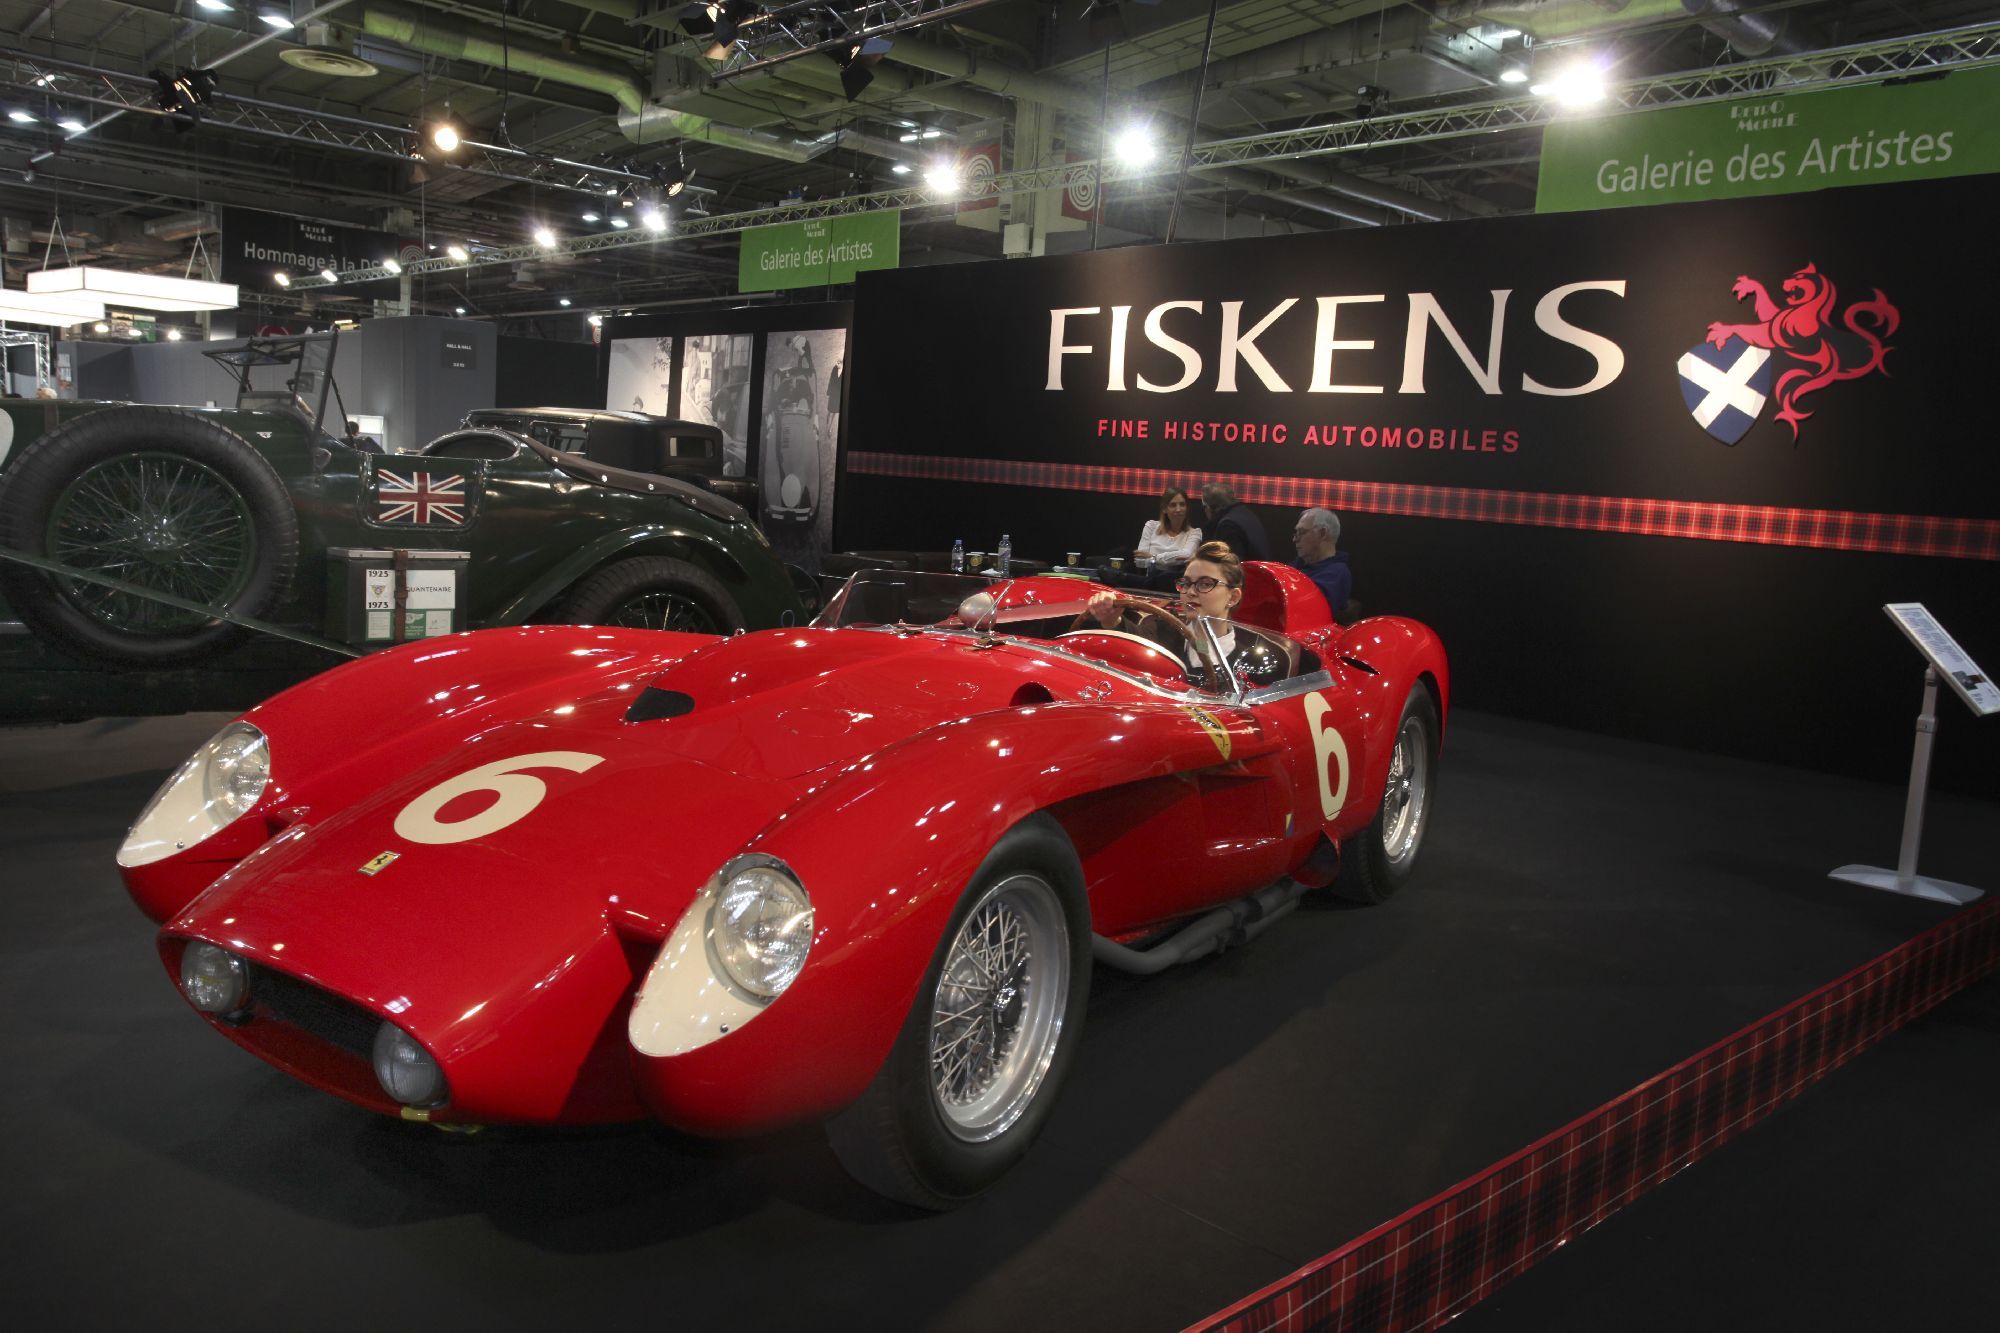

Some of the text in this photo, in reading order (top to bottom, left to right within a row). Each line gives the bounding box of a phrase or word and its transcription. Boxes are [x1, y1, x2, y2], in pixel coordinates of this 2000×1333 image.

[1596, 129, 1954, 193] Galerie des Artistes
[244, 241, 326, 272] Hommage
[328, 253, 338, 272] à
[342, 256, 356, 272] la
[760, 240, 873, 271] Galerie des Artistes
[1045, 279, 1626, 397] FISKENS
[1097, 419, 1520, 453] FINE HISTORIC AUTOMOBILES
[368, 601, 389, 609] 1973
[1303, 691, 1350, 821] 6
[394, 750, 607, 845] 6
